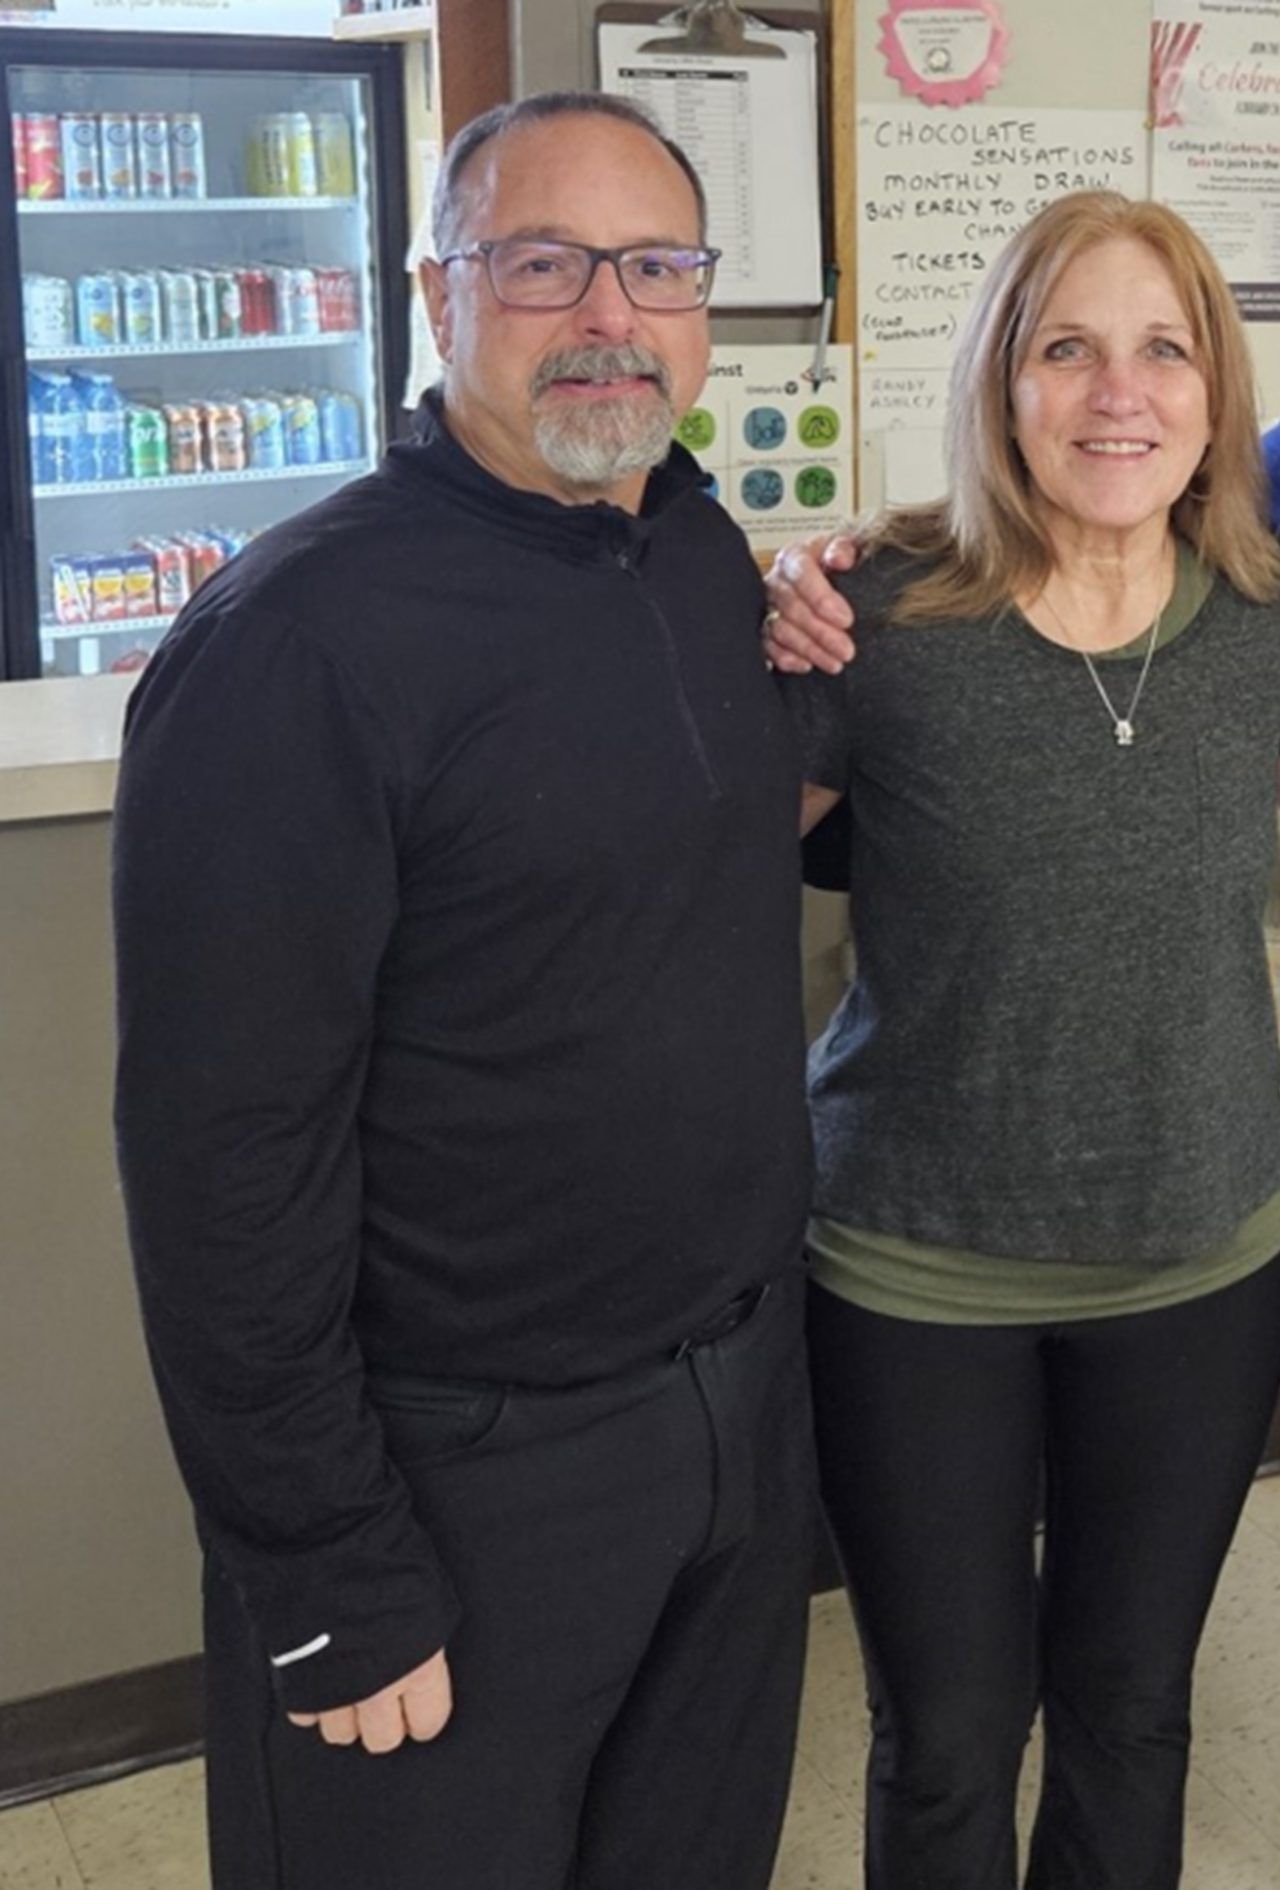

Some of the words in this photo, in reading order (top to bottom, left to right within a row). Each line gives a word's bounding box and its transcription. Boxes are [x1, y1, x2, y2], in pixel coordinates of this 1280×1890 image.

[875, 121, 1036, 147] CHOCOLATE
[971, 147, 1134, 166] SENSATIONS
[884, 173, 1000, 192] MONTHLY
[1034, 172, 1110, 191] DRAW
[865, 200, 904, 221] BUY
[916, 200, 980, 217] EARLY
[991, 200, 1015, 215] TO
[965, 222, 1024, 241] CHAN
[892, 252, 986, 272] TICKETS
[876, 281, 973, 303] CONTACT
[707, 364, 743, 377] inst
